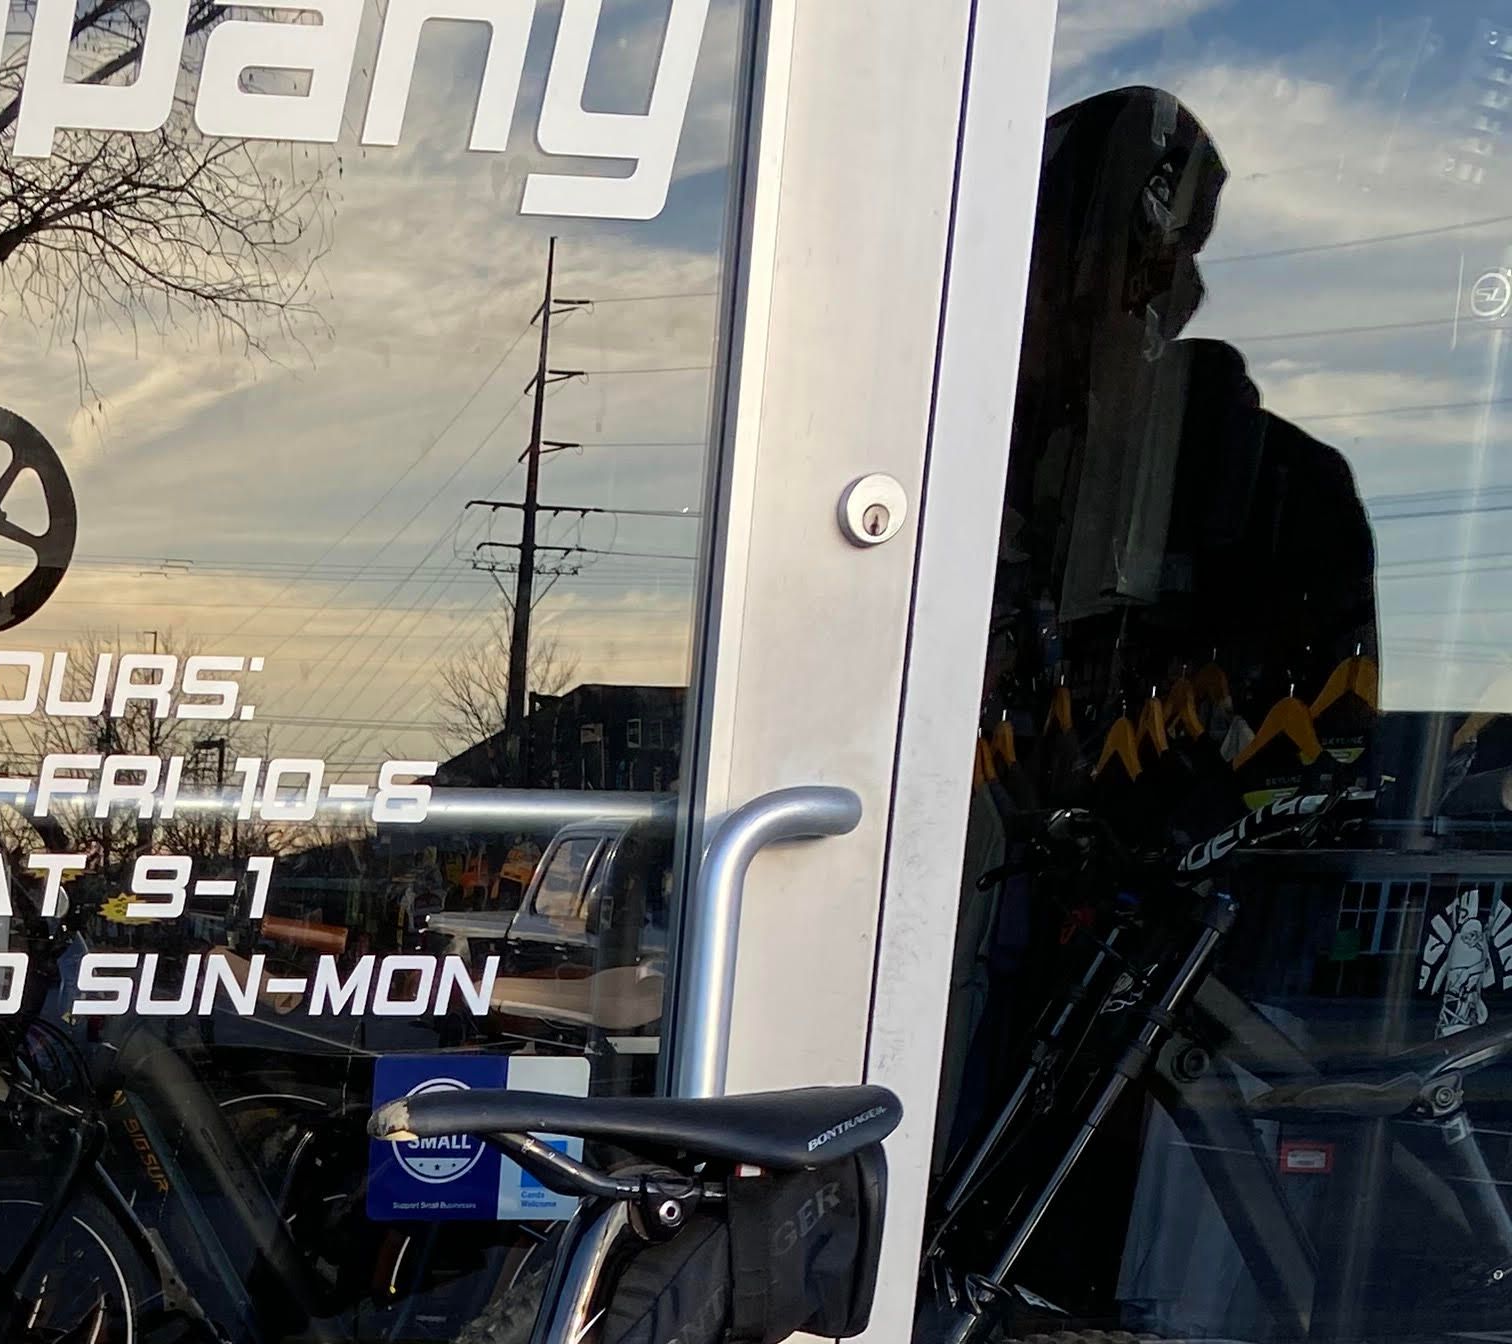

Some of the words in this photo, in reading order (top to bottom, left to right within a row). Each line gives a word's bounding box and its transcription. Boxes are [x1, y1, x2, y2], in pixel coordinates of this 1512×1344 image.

[232, 756, 438, 824] 10-6
[125, 855, 276, 919] 9-1
[75, 953, 500, 1017] SUN-MON
[407, 1134, 472, 1151] SMALL
[807, 1105, 888, 1153] BONTRAGER
